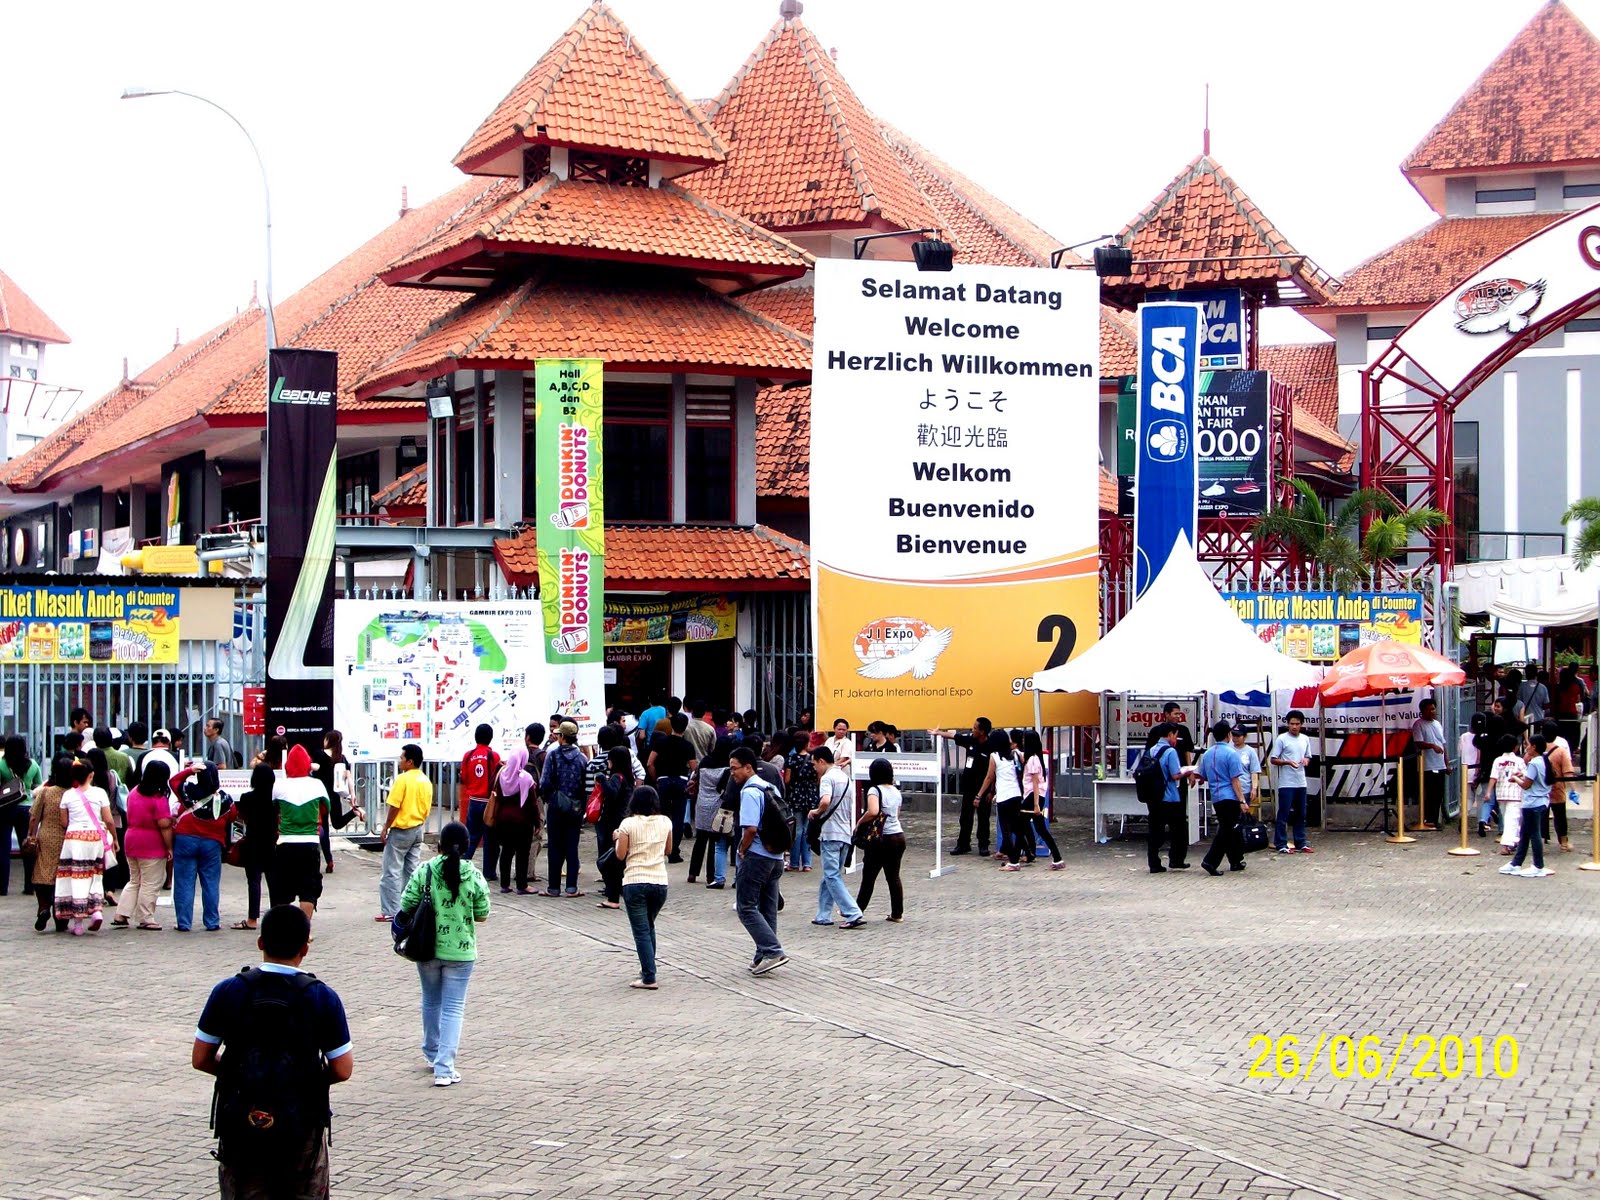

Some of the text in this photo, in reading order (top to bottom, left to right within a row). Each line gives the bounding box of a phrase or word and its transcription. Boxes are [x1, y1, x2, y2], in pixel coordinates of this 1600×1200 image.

[862, 278, 1062, 310] Selamat Datang
[904, 316, 1020, 340] Welcome
[560, 370, 580, 379] Hall
[828, 350, 1093, 378] Herzlich Willkommen
[1151, 326, 1186, 414] BCA
[560, 394, 580, 403] dan
[920, 388, 1008, 412] ようこそ
[563, 407, 576, 416] B2
[1214, 406, 1246, 416] TIKET
[1208, 418, 1233, 428] FAIR
[561, 424, 574, 500] DUNKIN'
[574, 428, 588, 500] DONUTS
[912, 462, 1011, 482] Welkom
[888, 498, 1035, 518] Buenvenido
[896, 534, 1028, 554] Bienvenue
[562, 548, 574, 624] DUNKIN'
[576, 552, 588, 624] DONUTS
[35, 589, 84, 618] Masuk
[87, 590, 124, 618] Anda
[126, 591, 135, 606] di
[138, 591, 176, 606] Counter
[1256, 596, 1289, 620] Tiket
[1292, 596, 1334, 620] Masuk
[1337, 596, 1370, 620] Anda
[1372, 596, 1380, 609] di
[1382, 596, 1416, 610] Counter
[885, 628, 913, 641] Expo
[1036, 614, 1077, 671] 2
[114, 642, 138, 661] 100
[833, 687, 973, 698] PT Jakarta International Expo
[1340, 715, 1379, 724] Discover
[1384, 713, 1397, 721] he
[1398, 711, 1422, 720] Value
